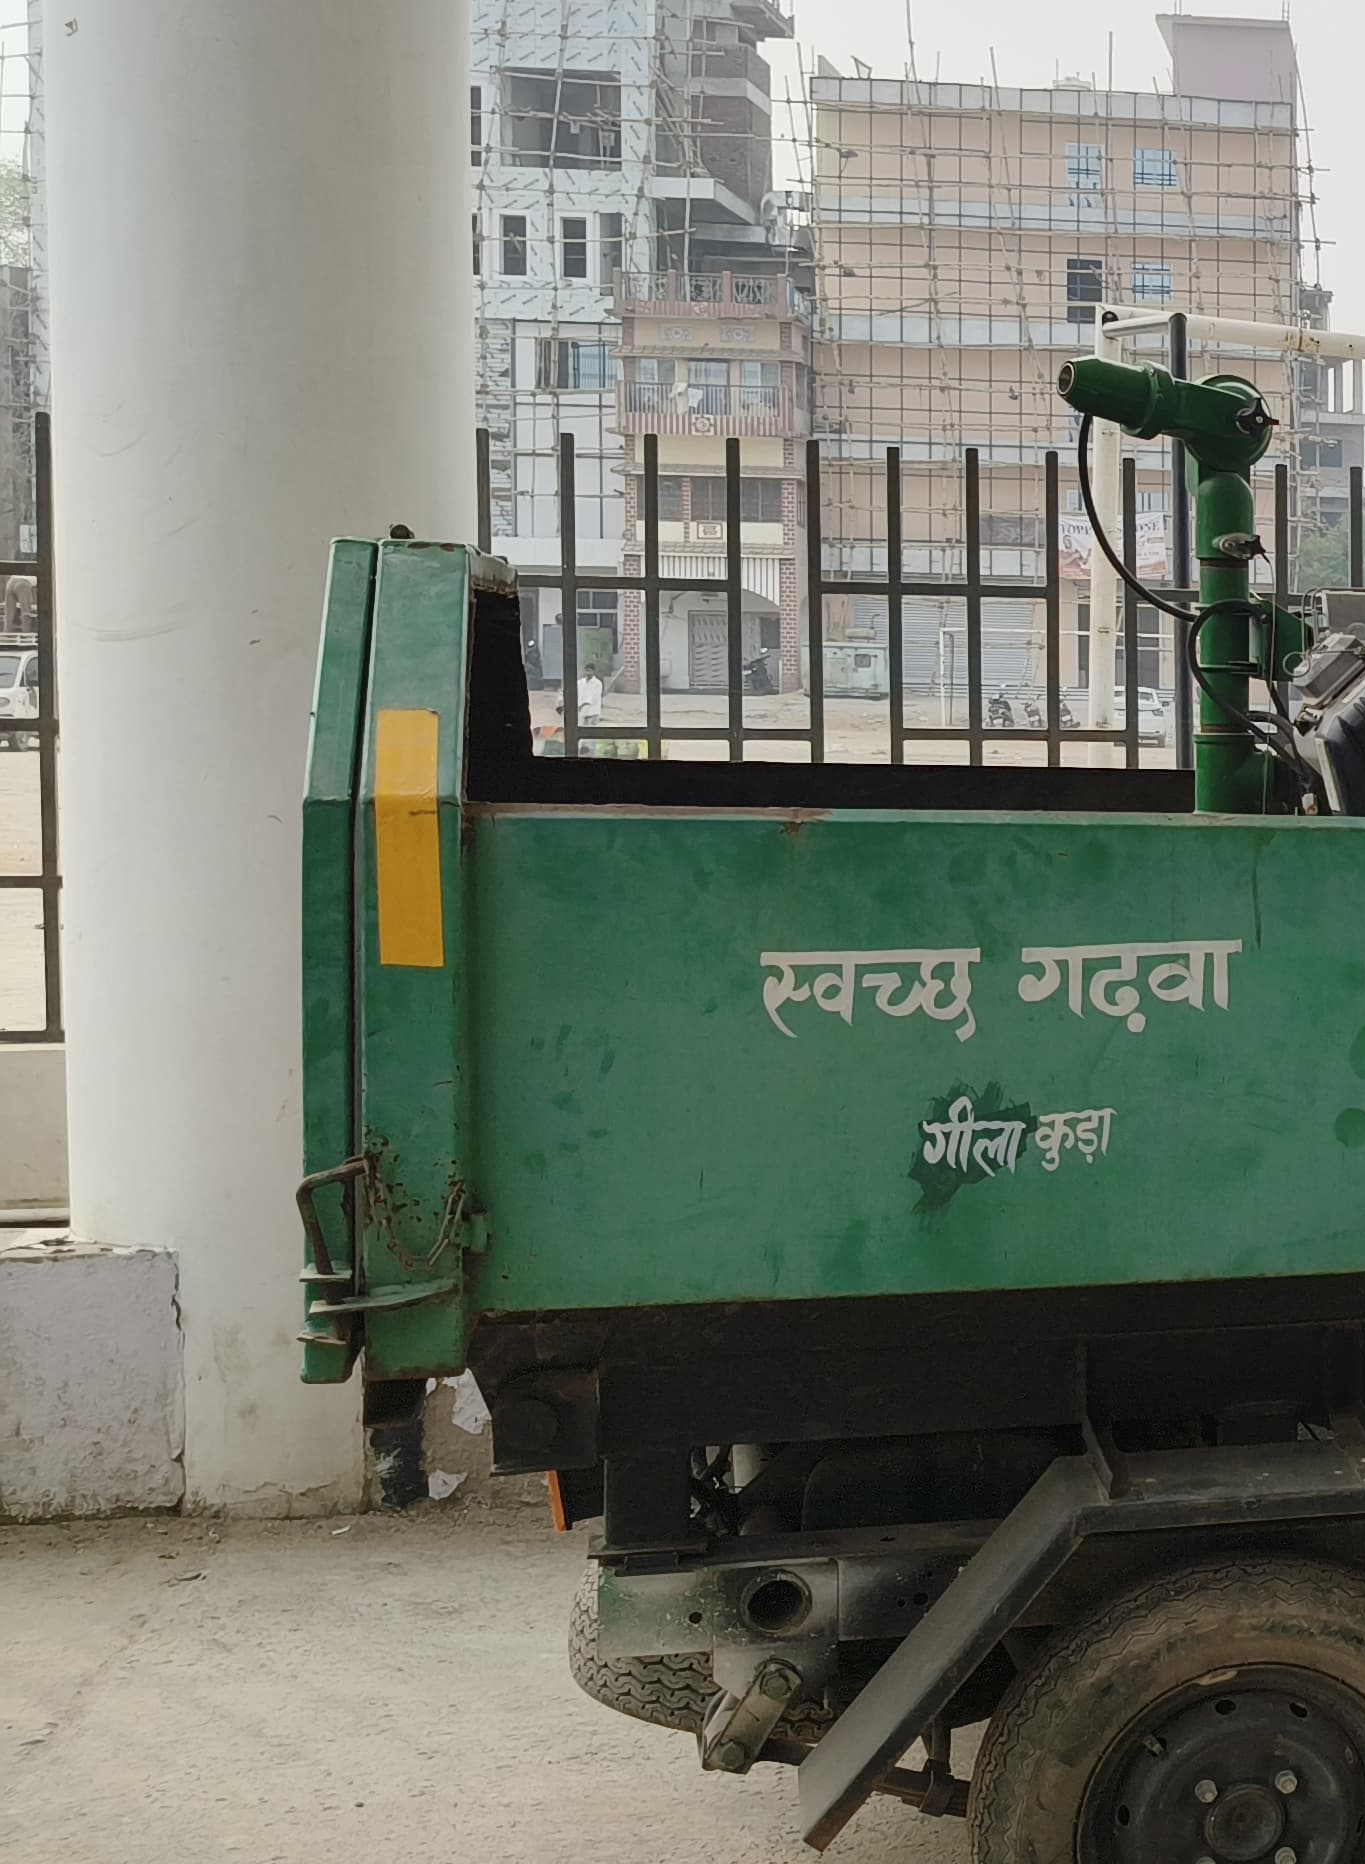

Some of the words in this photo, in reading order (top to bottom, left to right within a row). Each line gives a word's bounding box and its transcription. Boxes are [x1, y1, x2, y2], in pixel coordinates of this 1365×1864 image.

[760, 947, 981, 1042] स्वच्छ
[1018, 939, 1243, 1033] गढ़वा
[922, 1096, 1026, 1177] गीला
[1034, 1107, 1118, 1172] कुड़ा
